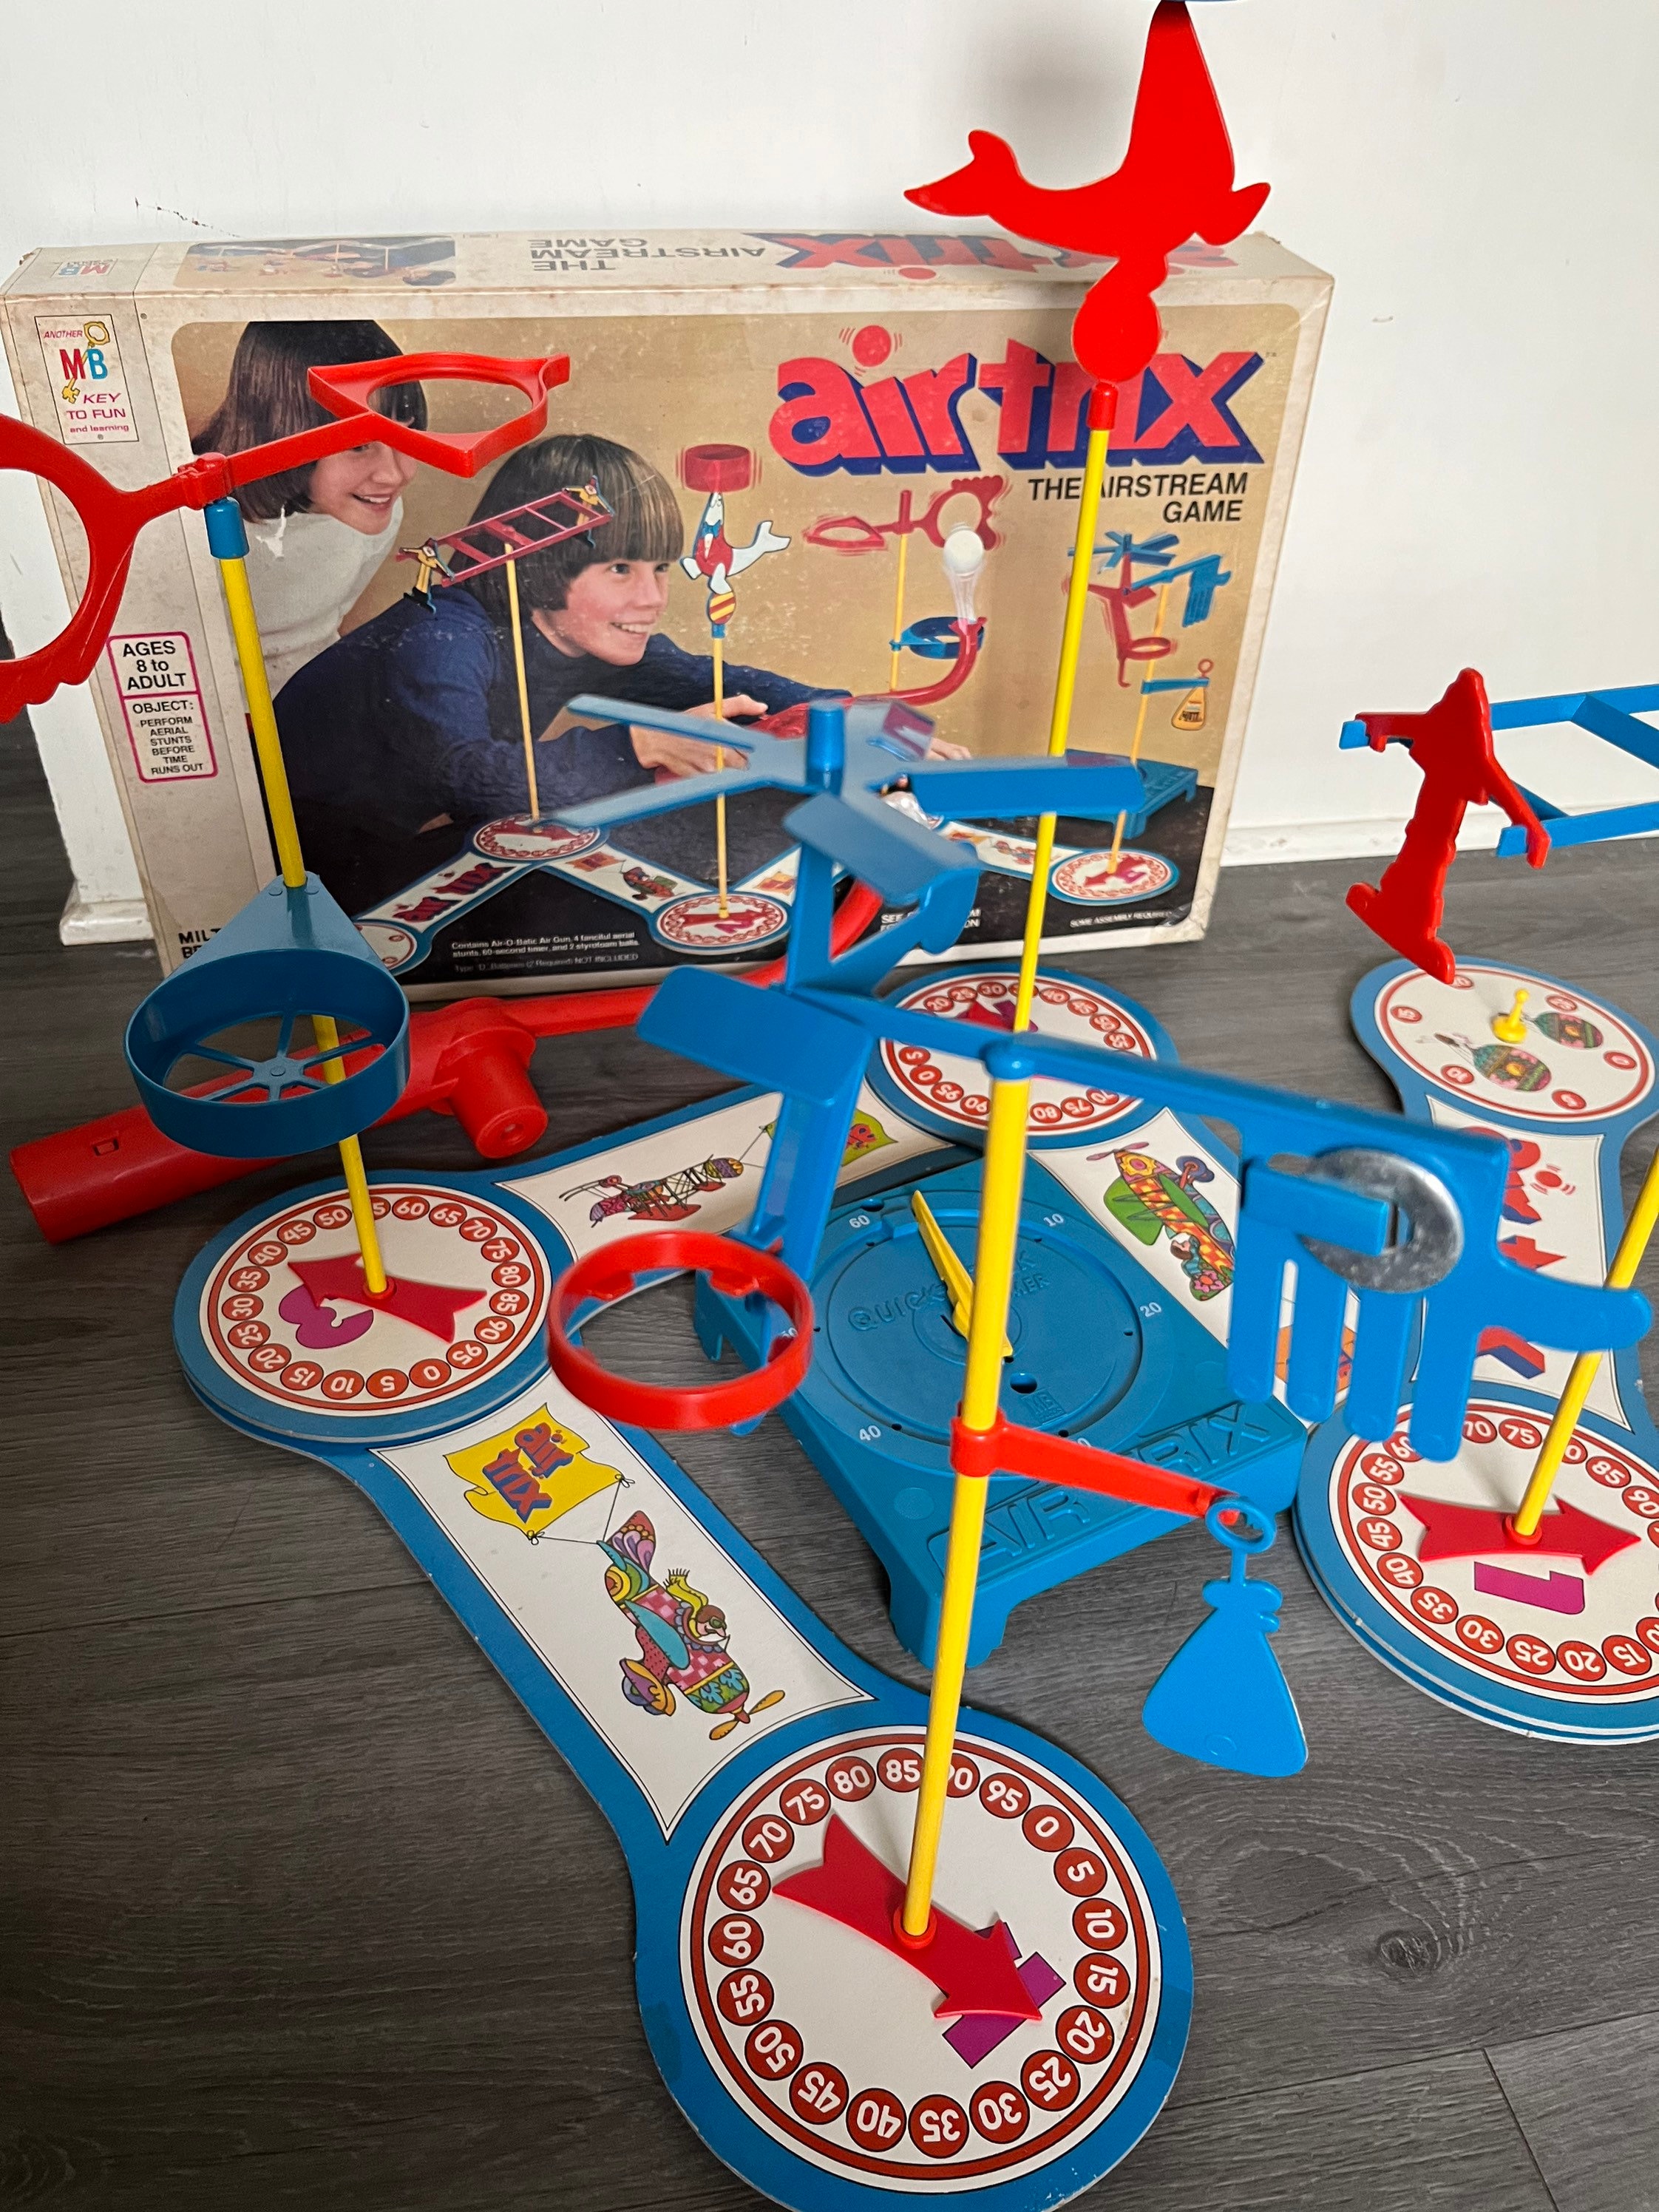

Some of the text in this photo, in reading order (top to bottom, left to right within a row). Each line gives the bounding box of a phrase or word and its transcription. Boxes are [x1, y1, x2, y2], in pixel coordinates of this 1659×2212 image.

[528, 238, 648, 249] GAME
[533, 259, 616, 271] THE
[44, 330, 83, 339] ANOTHER
[59, 348, 108, 380] MB
[83, 393, 121, 404] KEY
[67, 408, 126, 420] TO FUN
[90, 424, 129, 433] learning
[1028, 477, 1082, 501] THE
[1163, 499, 1243, 523] GAME
[123, 640, 176, 657] AGES
[136, 659, 169, 673] 8 to
[127, 673, 186, 691] ADULT
[132, 699, 194, 714] OBJECT:
[140, 716, 192, 727] PERFORM
[150, 727, 189, 736] AERIAL
[150, 736, 192, 747] STUNTS
[152, 745, 195, 756] BEFORE
[151, 763, 204, 775] RUNS OUT
[163, 755, 188, 764] TIME
[906, 1051, 923, 1060] 5
[917, 1071, 935, 1081] 0
[936, 1084, 960, 1100] 95
[1033, 1106, 1058, 1119] 80
[1065, 1099, 1090, 1115] 75
[318, 1209, 348, 1227] 50
[373, 1202, 386, 1215] 5
[396, 1201, 425, 1216] 60
[432, 1208, 462, 1224] 65
[464, 1219, 492, 1239] 70
[849, 1215, 871, 1228] 60
[1043, 1213, 1065, 1227] 10
[283, 1223, 311, 1241] 45
[254, 1244, 282, 1264] 40
[486, 1239, 512, 1261] 75
[236, 1270, 262, 1290] 35
[500, 1265, 522, 1286] 80
[231, 1297, 254, 1317] 30
[496, 1292, 520, 1312] 85
[1140, 1301, 1162, 1318] 20
[237, 1324, 263, 1346] 25
[480, 1320, 508, 1340] 90
[255, 1348, 285, 1369] 20
[452, 1343, 483, 1365] 95
[288, 1367, 316, 1387] 15
[423, 1365, 441, 1381] 0
[330, 1376, 355, 1394] 10
[380, 1375, 396, 1392] 5
[859, 1425, 882, 1442] 40
[1138, 1402, 1272, 1473] RIX
[1504, 1424, 1536, 1445] 75
[1564, 1445, 1581, 1456] 0
[1371, 1456, 1399, 1482] 55
[1592, 1461, 1625, 1485] 85
[1363, 1486, 1387, 1512] 50
[1628, 1489, 1659, 1515] 90
[1367, 1522, 1391, 1548] 45
[1385, 1558, 1415, 1586] 40
[1418, 1592, 1453, 1620] 35
[1462, 1620, 1499, 1649] 30
[1515, 1641, 1549, 1666] 25
[1564, 1649, 1600, 1673] 20
[1612, 1643, 1646, 1667] 15
[833, 1765, 870, 1794] 80
[886, 1759, 920, 1783] 85
[785, 1786, 825, 1821] 75
[986, 1780, 1023, 1812] 95
[1035, 1816, 1059, 1838] 0
[749, 1821, 787, 1858] 70
[1067, 1860, 1096, 1882] 5
[729, 1867, 762, 1905] 65
[1085, 1908, 1116, 1938] 10
[722, 1921, 752, 1960] 60
[1087, 1964, 1119, 1995] 15
[729, 1975, 765, 2018] 55
[1066, 2012, 1105, 2055] 20
[754, 2027, 795, 2073] 50
[1028, 2057, 1071, 2102] 25
[797, 2071, 841, 2114] 45
[856, 2100, 900, 2139] 40
[978, 2092, 1022, 2131] 30
[919, 2108, 960, 2143] 35
